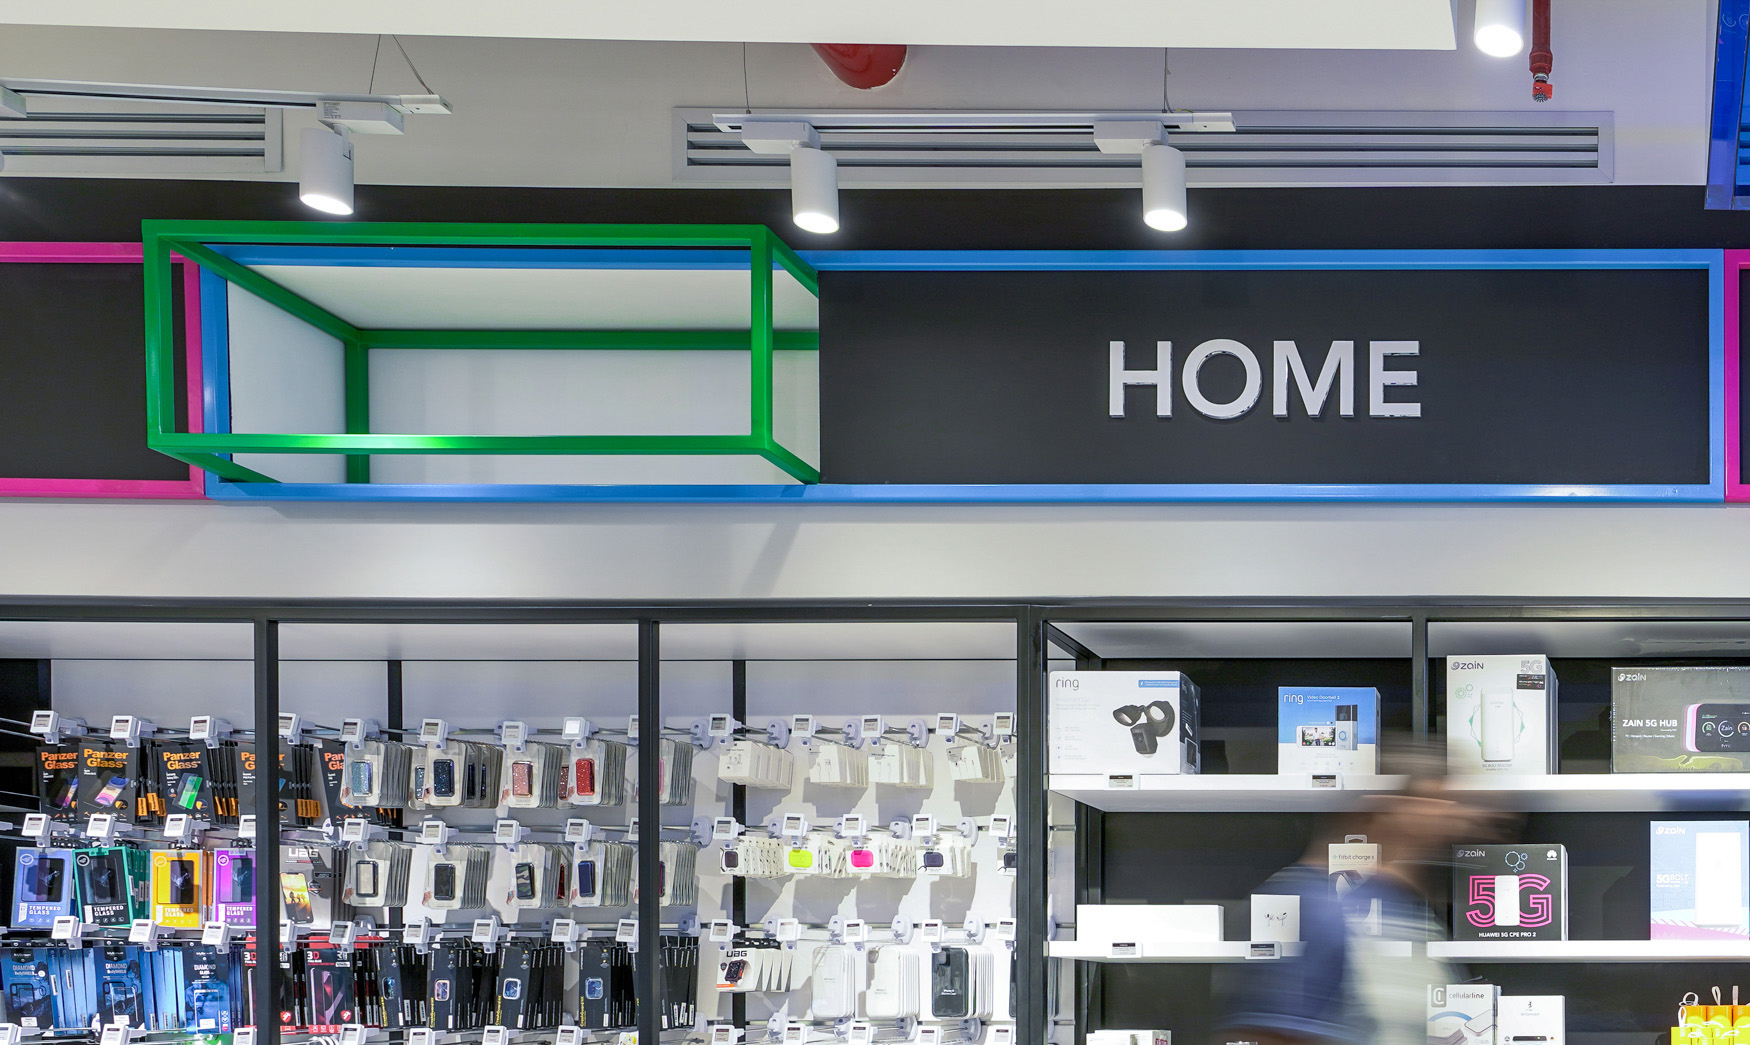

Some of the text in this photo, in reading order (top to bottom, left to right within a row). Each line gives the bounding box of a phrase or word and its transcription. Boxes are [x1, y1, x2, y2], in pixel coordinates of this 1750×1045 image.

[1110, 339, 1420, 419] HOME
[1520, 660, 1543, 673] 5G
[1055, 677, 1080, 691] ring
[1283, 693, 1304, 705] ring
[1622, 719, 1678, 727] ZAIN 5G HUB
[41, 752, 78, 762] Panzer
[83, 748, 129, 760] Panzer
[163, 751, 200, 762] Panzer
[1465, 874, 1552, 928] 5G
[306, 951, 320, 960] 3D
